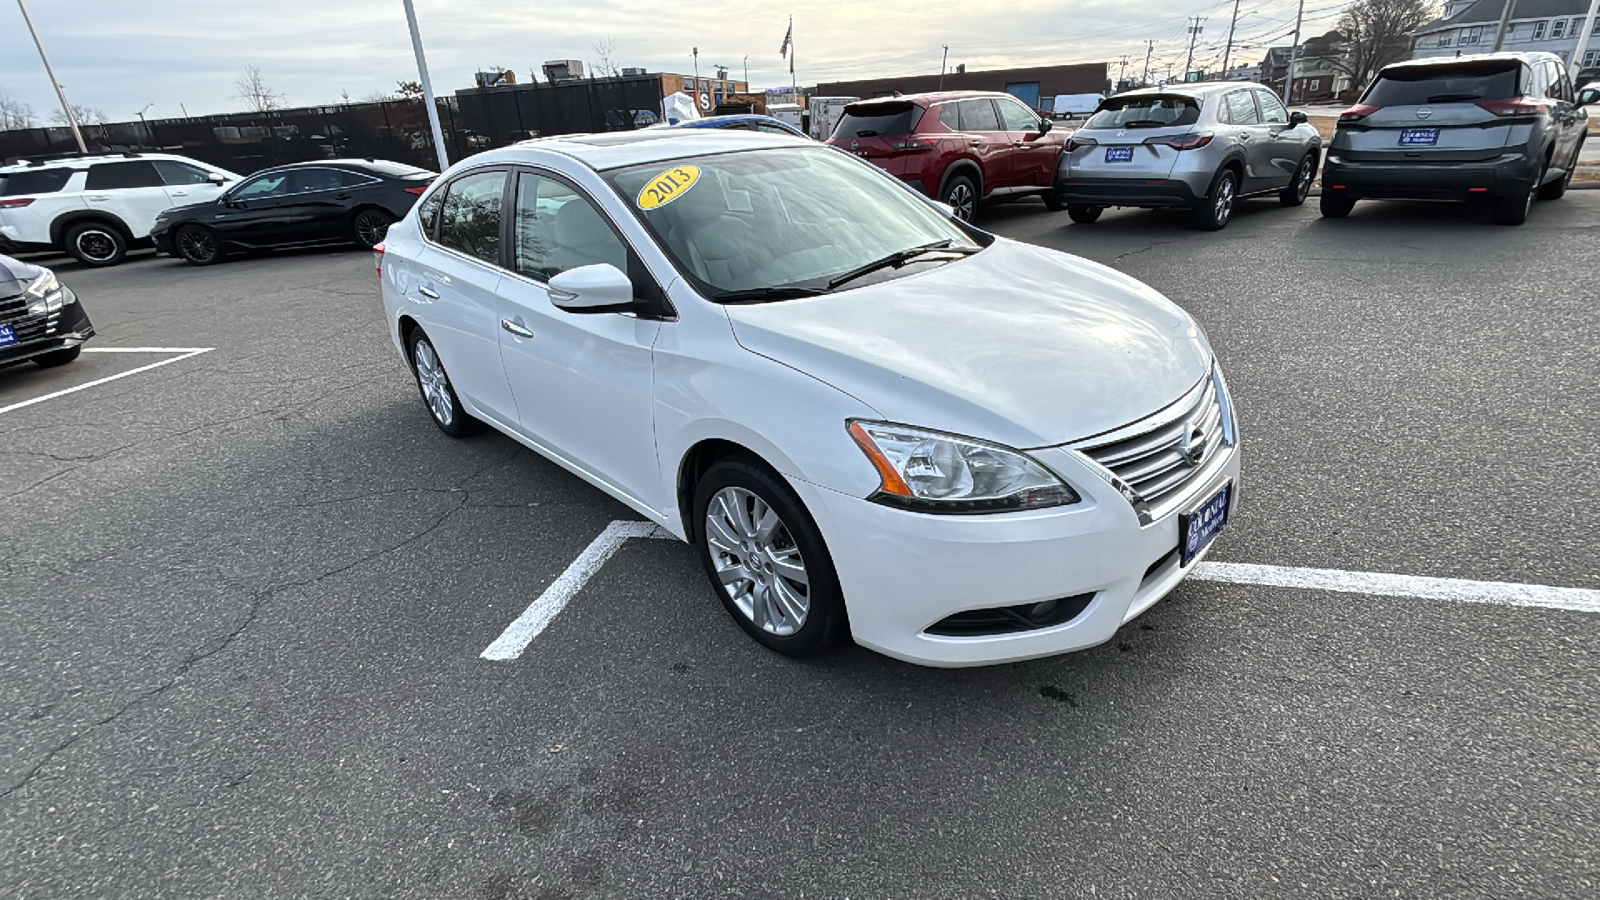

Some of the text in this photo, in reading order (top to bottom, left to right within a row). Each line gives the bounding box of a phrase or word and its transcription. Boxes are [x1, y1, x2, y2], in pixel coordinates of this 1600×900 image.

[647, 168, 691, 204] 2013
[1188, 492, 1228, 537] COLONIAL
[1201, 509, 1225, 538] Medford
